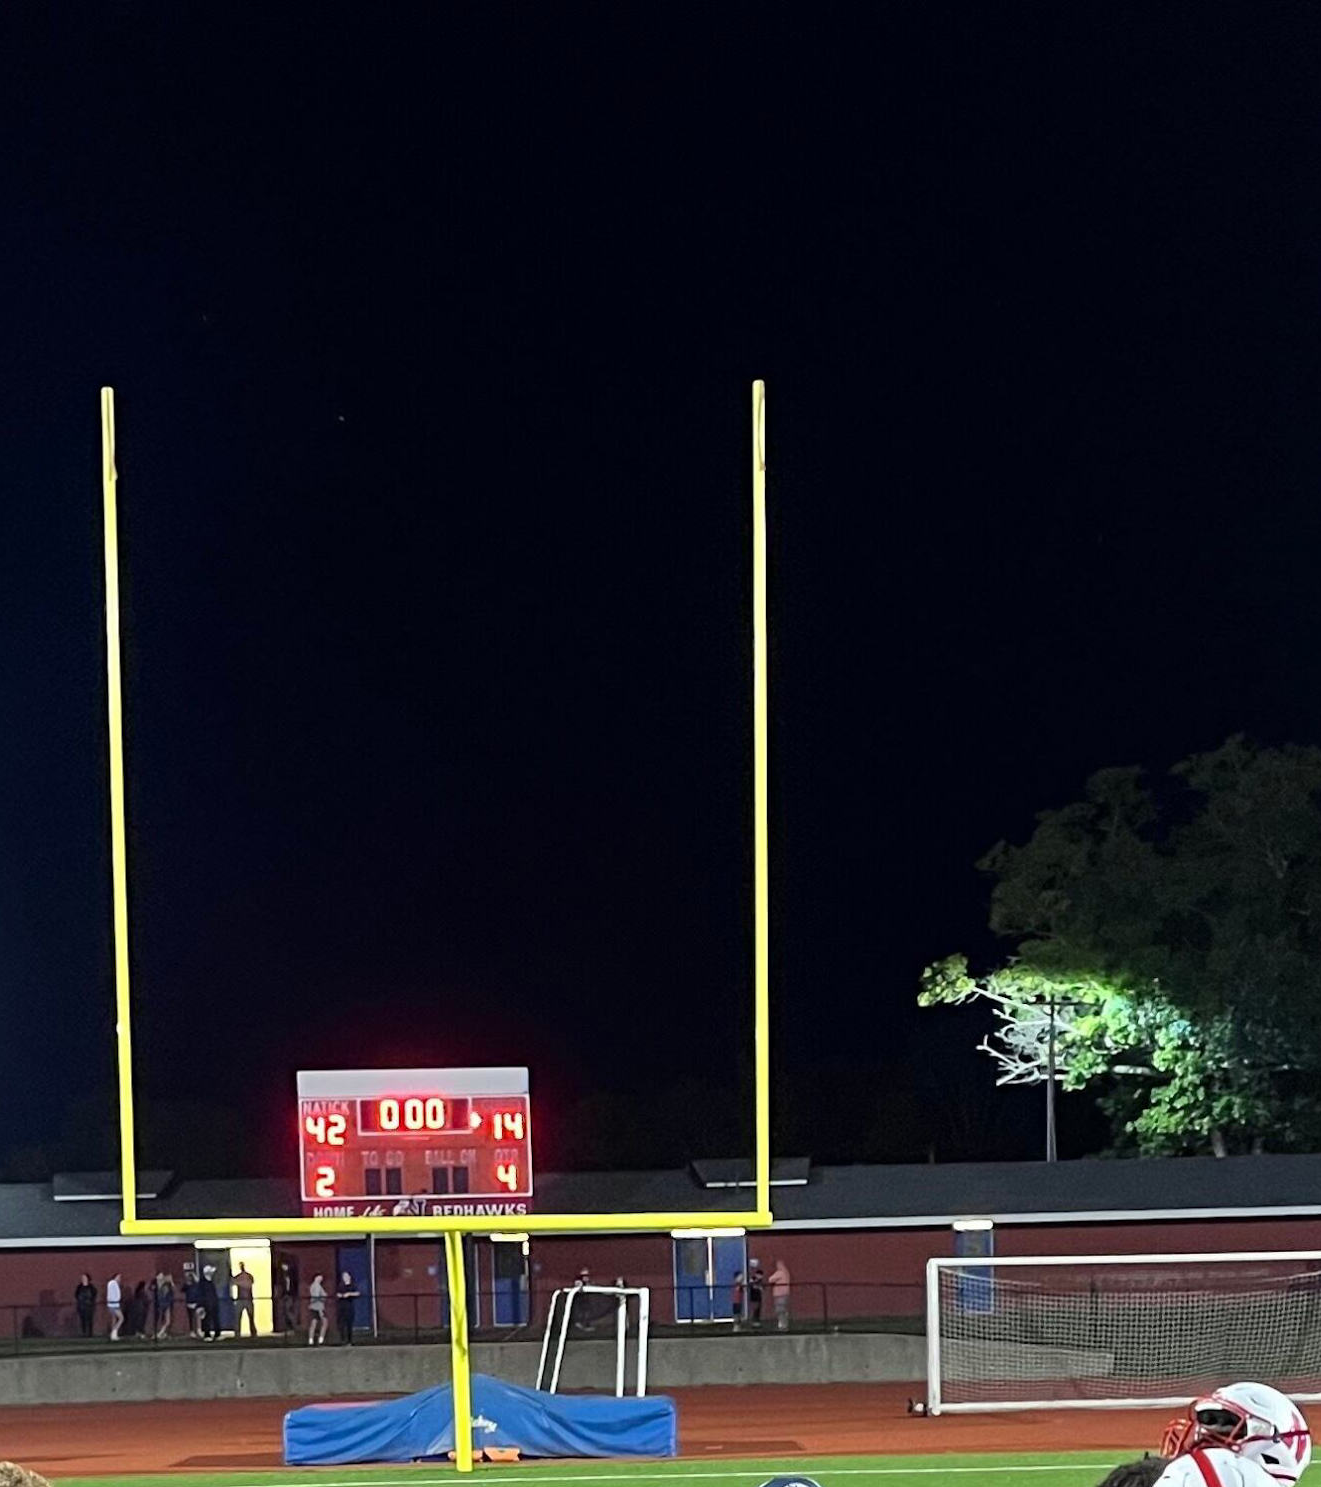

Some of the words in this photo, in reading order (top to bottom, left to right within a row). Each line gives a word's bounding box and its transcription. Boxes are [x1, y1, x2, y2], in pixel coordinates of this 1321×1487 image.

[302, 1101, 350, 1115] NATICK
[305, 1114, 347, 1146] 42
[493, 1112, 524, 1140] 14
[315, 1166, 335, 1198] 2
[497, 1164, 518, 1192] 4
[313, 1206, 355, 1218] HOME
[432, 1203, 527, 1216] REDHAWKS
